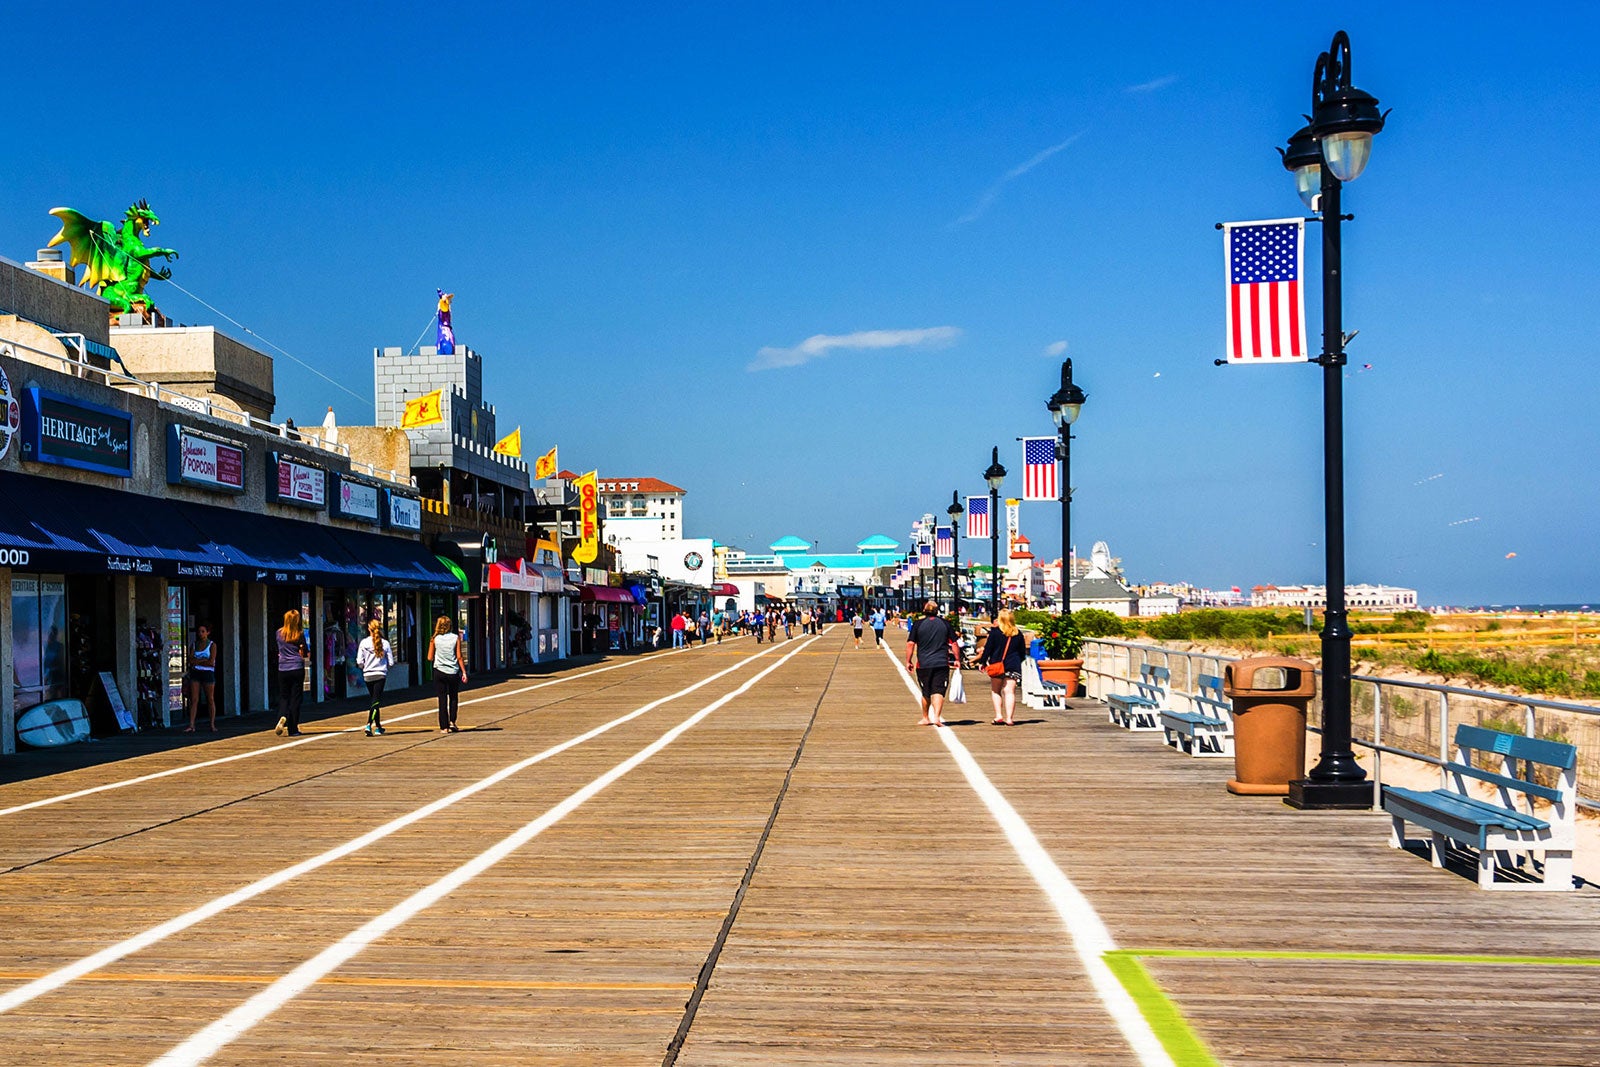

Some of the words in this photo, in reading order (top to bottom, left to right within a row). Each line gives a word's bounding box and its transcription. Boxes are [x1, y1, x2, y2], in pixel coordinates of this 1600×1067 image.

[41, 416, 98, 446] HERITAGE
[112, 438, 128, 454] Sport
[187, 457, 216, 477] POPCORN
[581, 483, 595, 540] GOLF
[107, 556, 132, 571] Surfboards
[136, 559, 153, 573] Rentals
[177, 562, 193, 575] Lessons
